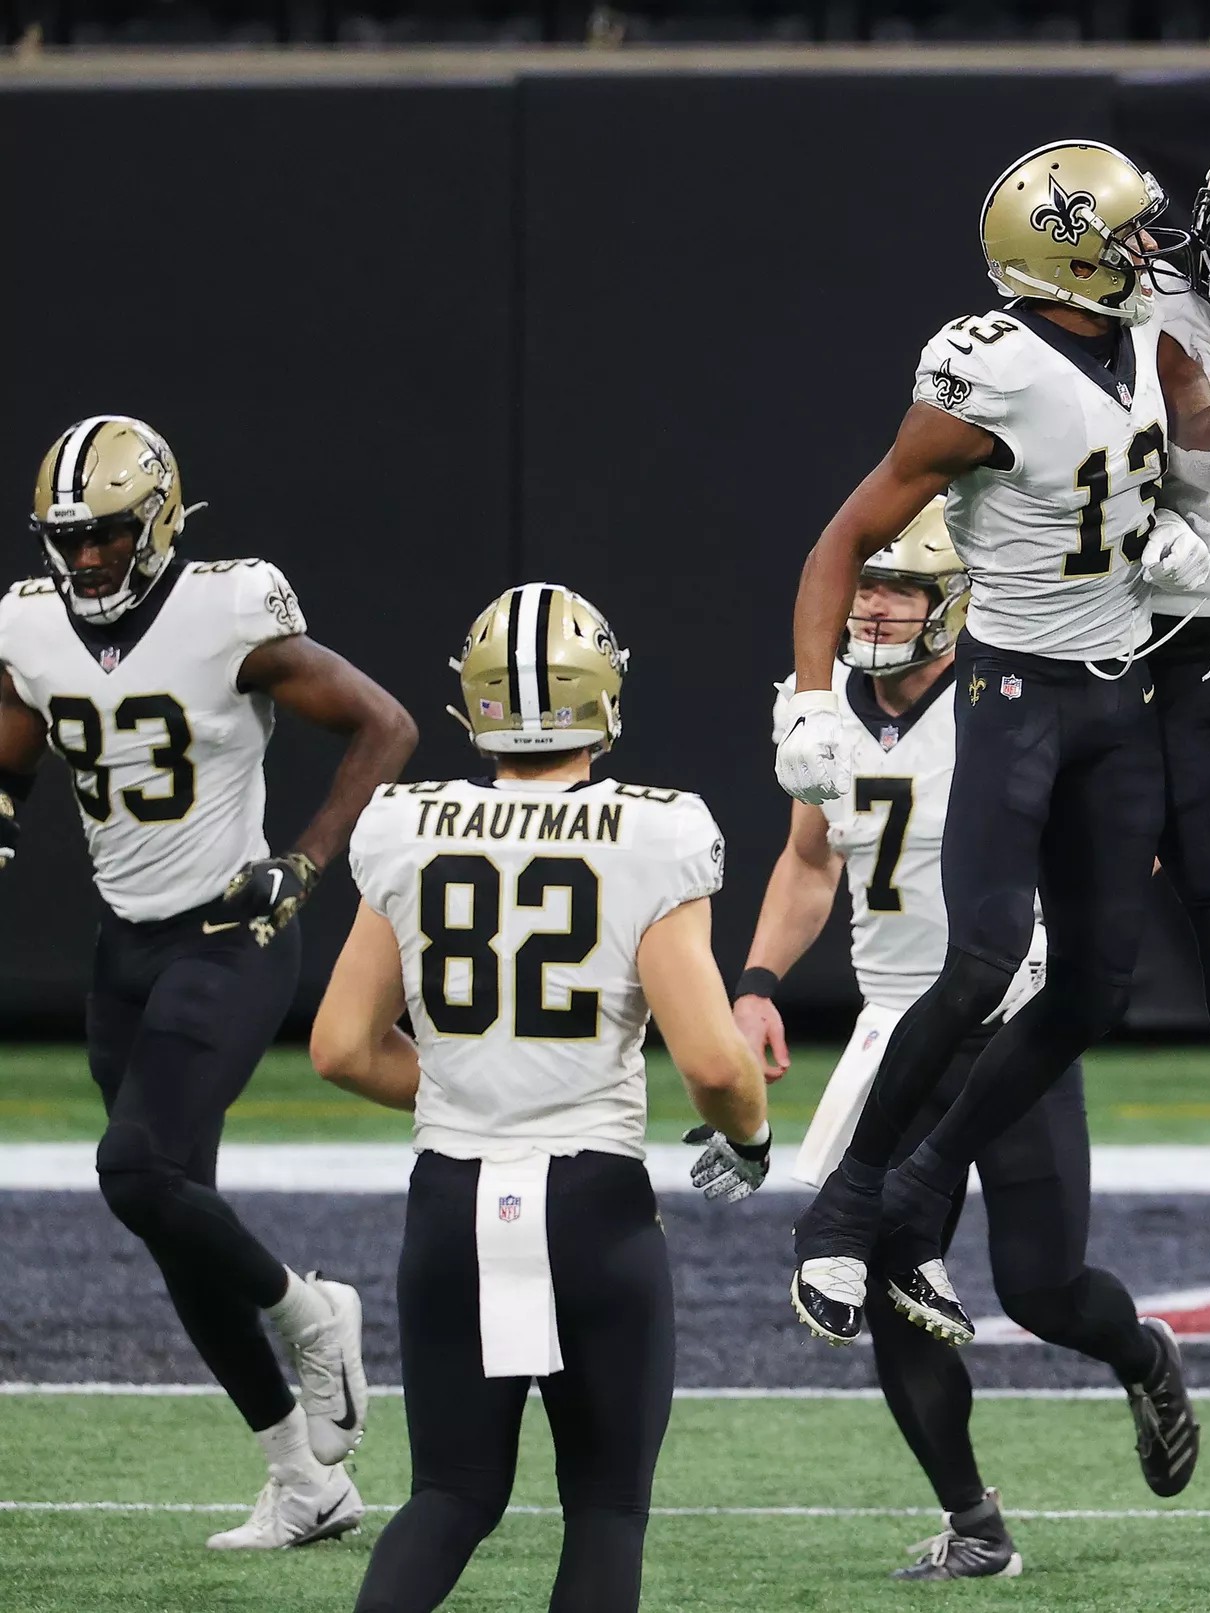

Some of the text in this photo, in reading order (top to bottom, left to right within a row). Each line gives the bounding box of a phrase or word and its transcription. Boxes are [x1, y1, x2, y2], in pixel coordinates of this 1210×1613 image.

[1061, 419, 1169, 580] 13
[47, 693, 194, 824] 83
[416, 799, 623, 842] TRAUTMAN
[852, 775, 916, 914] 7
[418, 853, 601, 1039] 82
